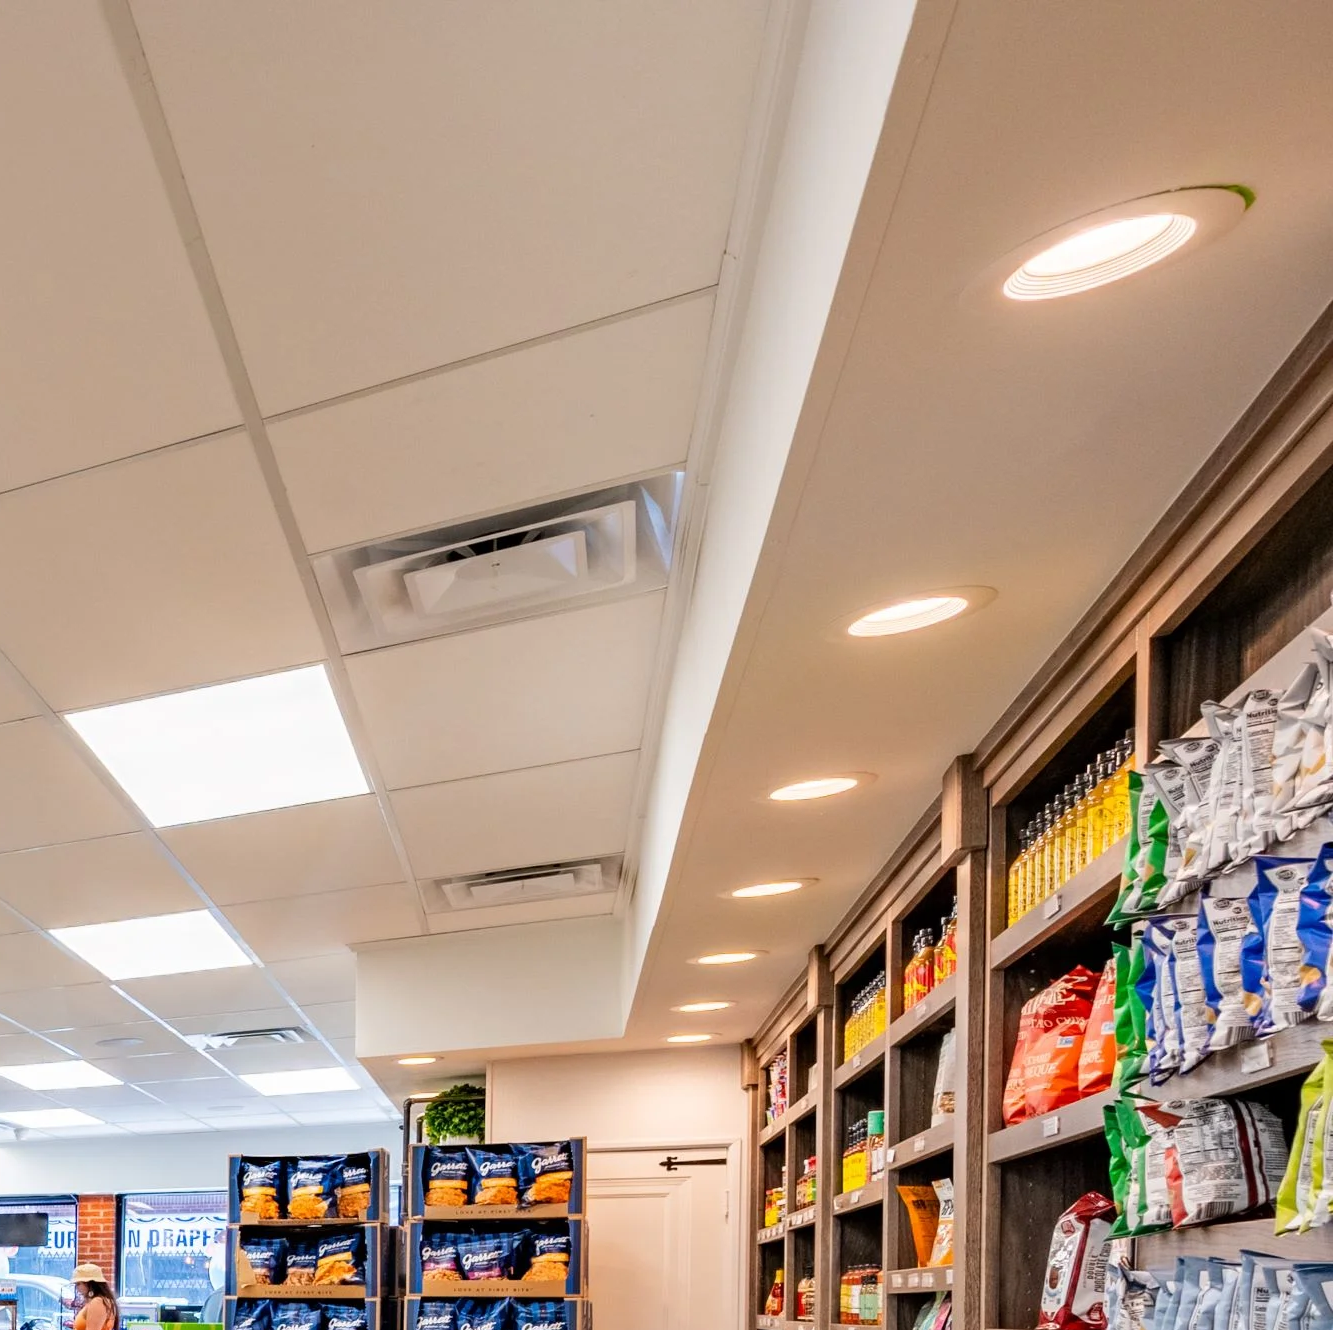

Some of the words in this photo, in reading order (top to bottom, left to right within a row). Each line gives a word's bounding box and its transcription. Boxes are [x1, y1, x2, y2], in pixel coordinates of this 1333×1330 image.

[1213, 915, 1250, 926] Nutrition
[1175, 937, 1198, 946] Nutriti
[431, 1162, 468, 1177] Garrett
[532, 1152, 569, 1173] Garrett
[318, 1238, 356, 1256] Garrett
[462, 1250, 503, 1270] Garrett
[1087, 1255, 1098, 1280] DOUBLE
[1094, 1259, 1109, 1293] CHOCOLATE
[1102, 1242, 1112, 1258] CHIP
